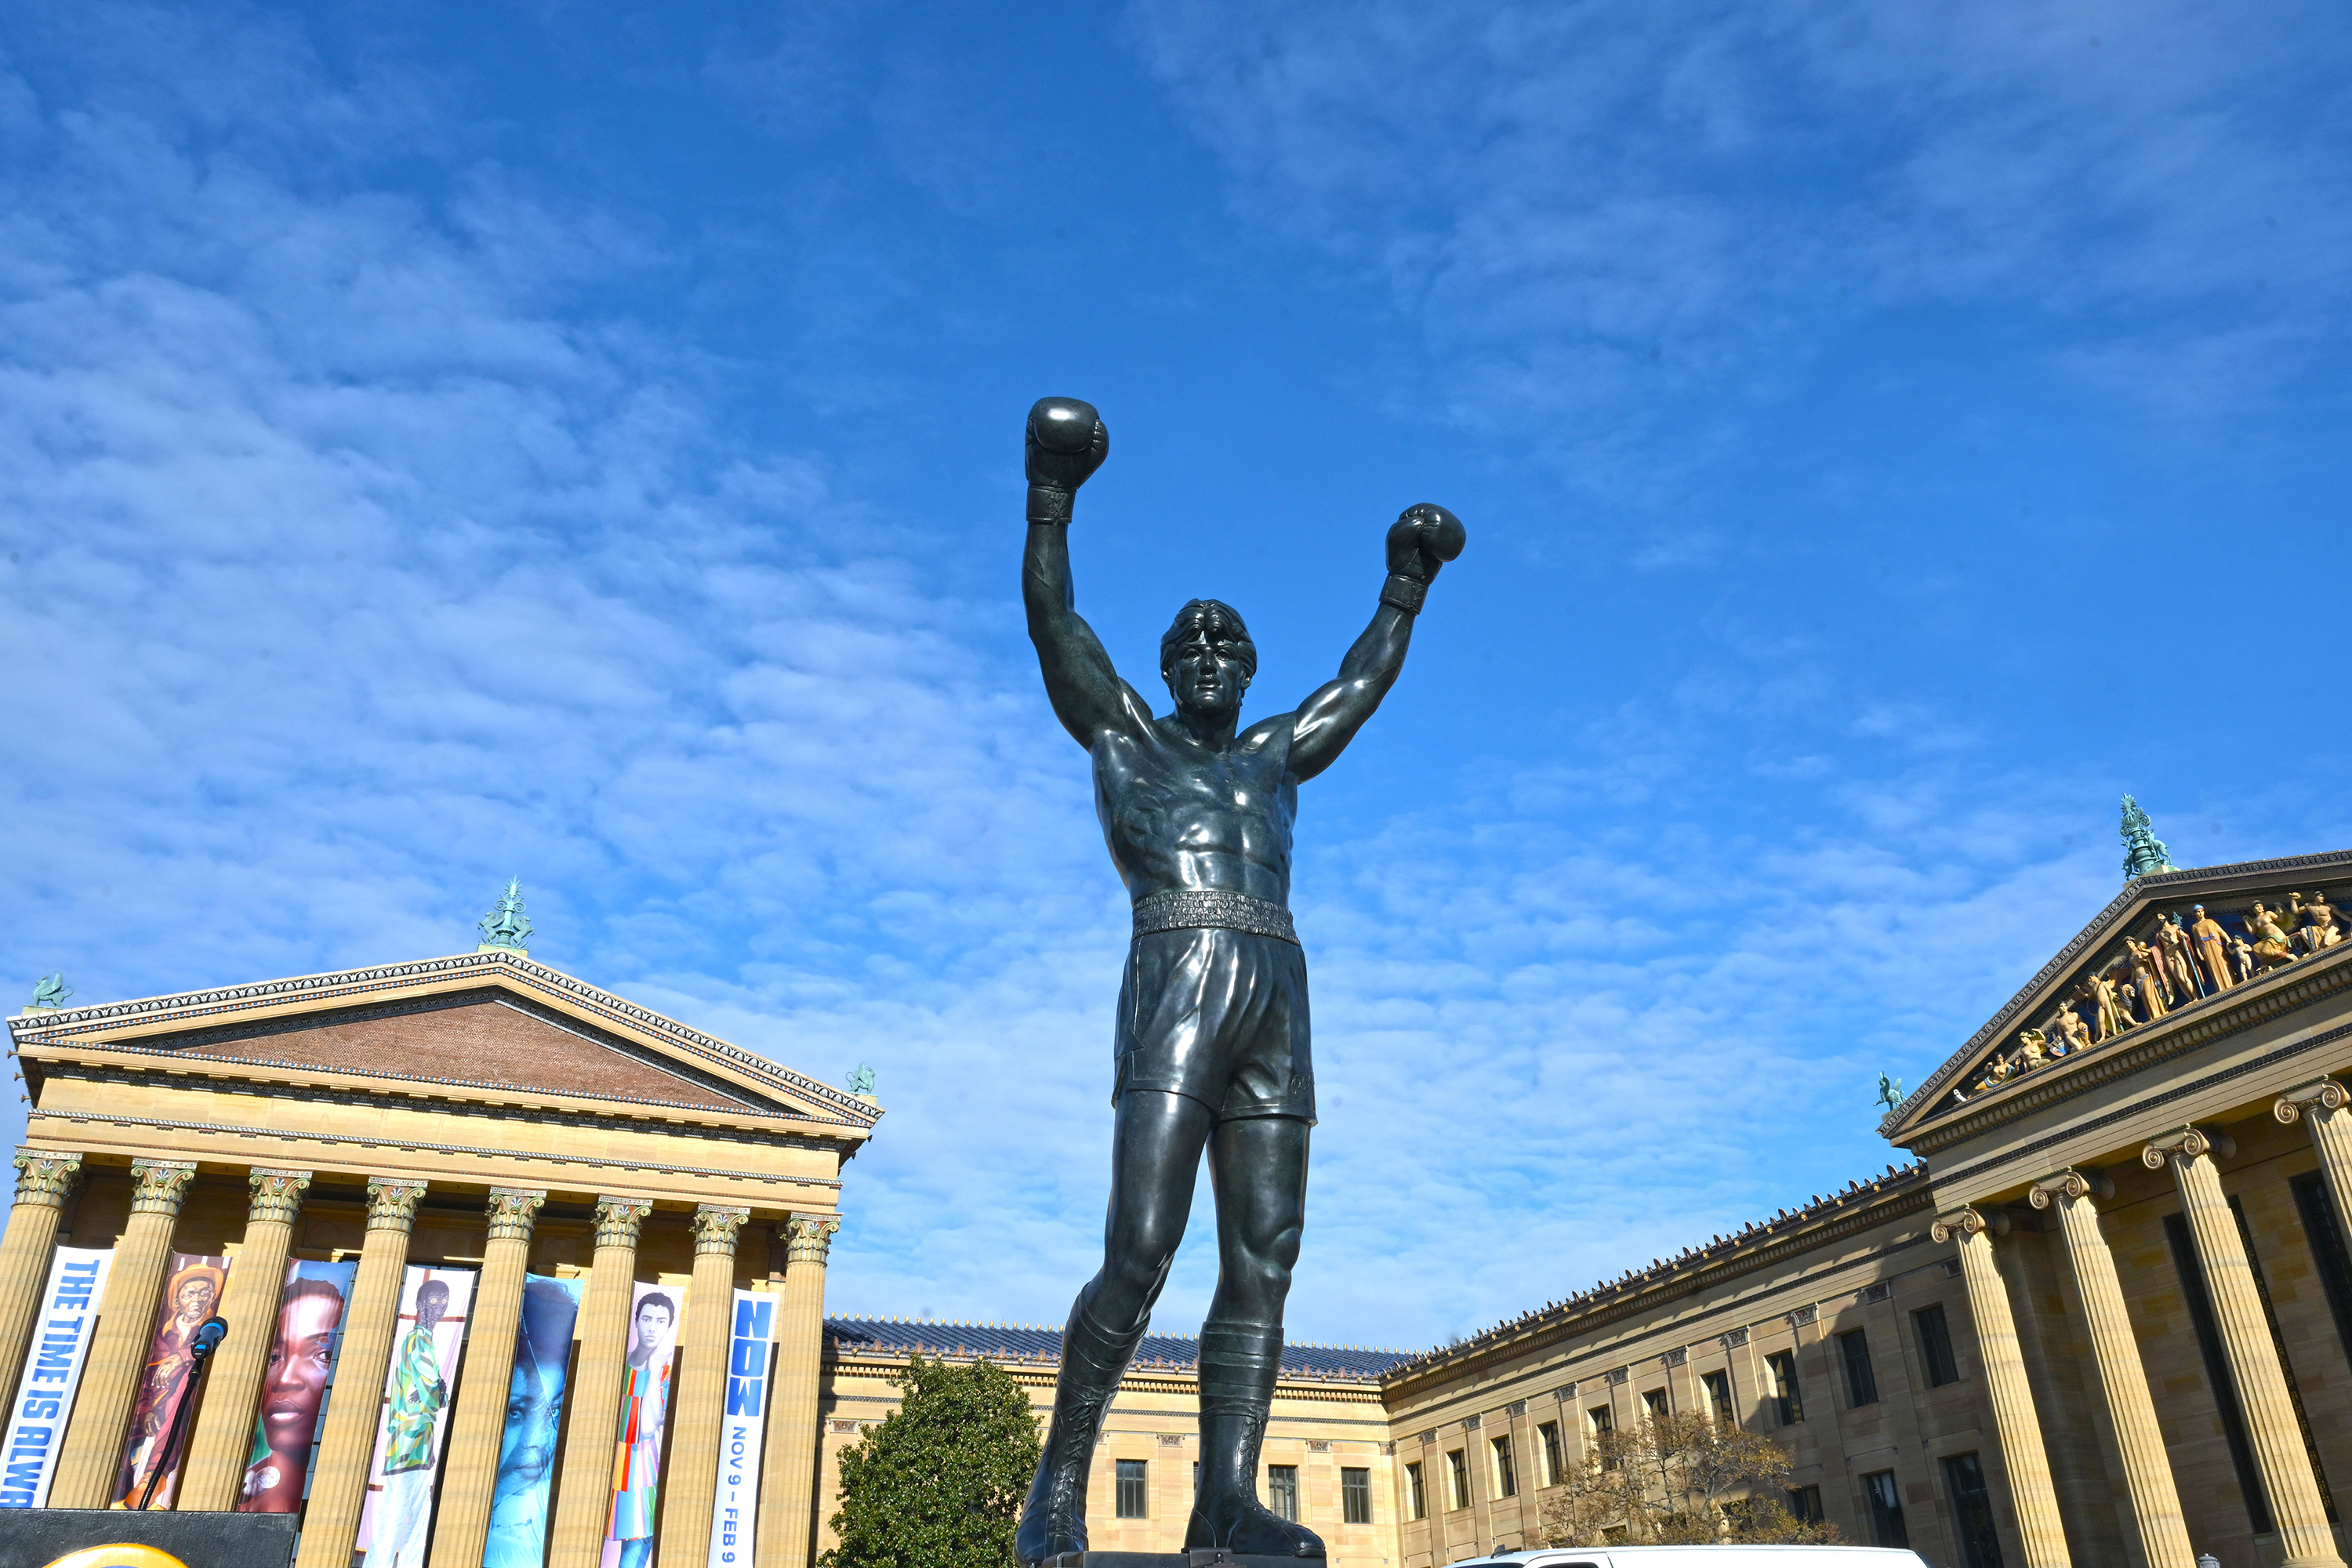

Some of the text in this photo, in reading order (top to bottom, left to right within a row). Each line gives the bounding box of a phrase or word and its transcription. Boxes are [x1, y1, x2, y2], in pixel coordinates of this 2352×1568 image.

[53, 1259, 100, 1311] THE
[31, 1316, 85, 1383] TIME
[727, 1299, 772, 1417] NOW
[22, 1389, 64, 1420] IS
[730, 1426, 746, 1469] NOV
[728, 1474, 742, 1486] 9
[723, 1508, 739, 1546] FEB
[721, 1552, 735, 1563] 9
